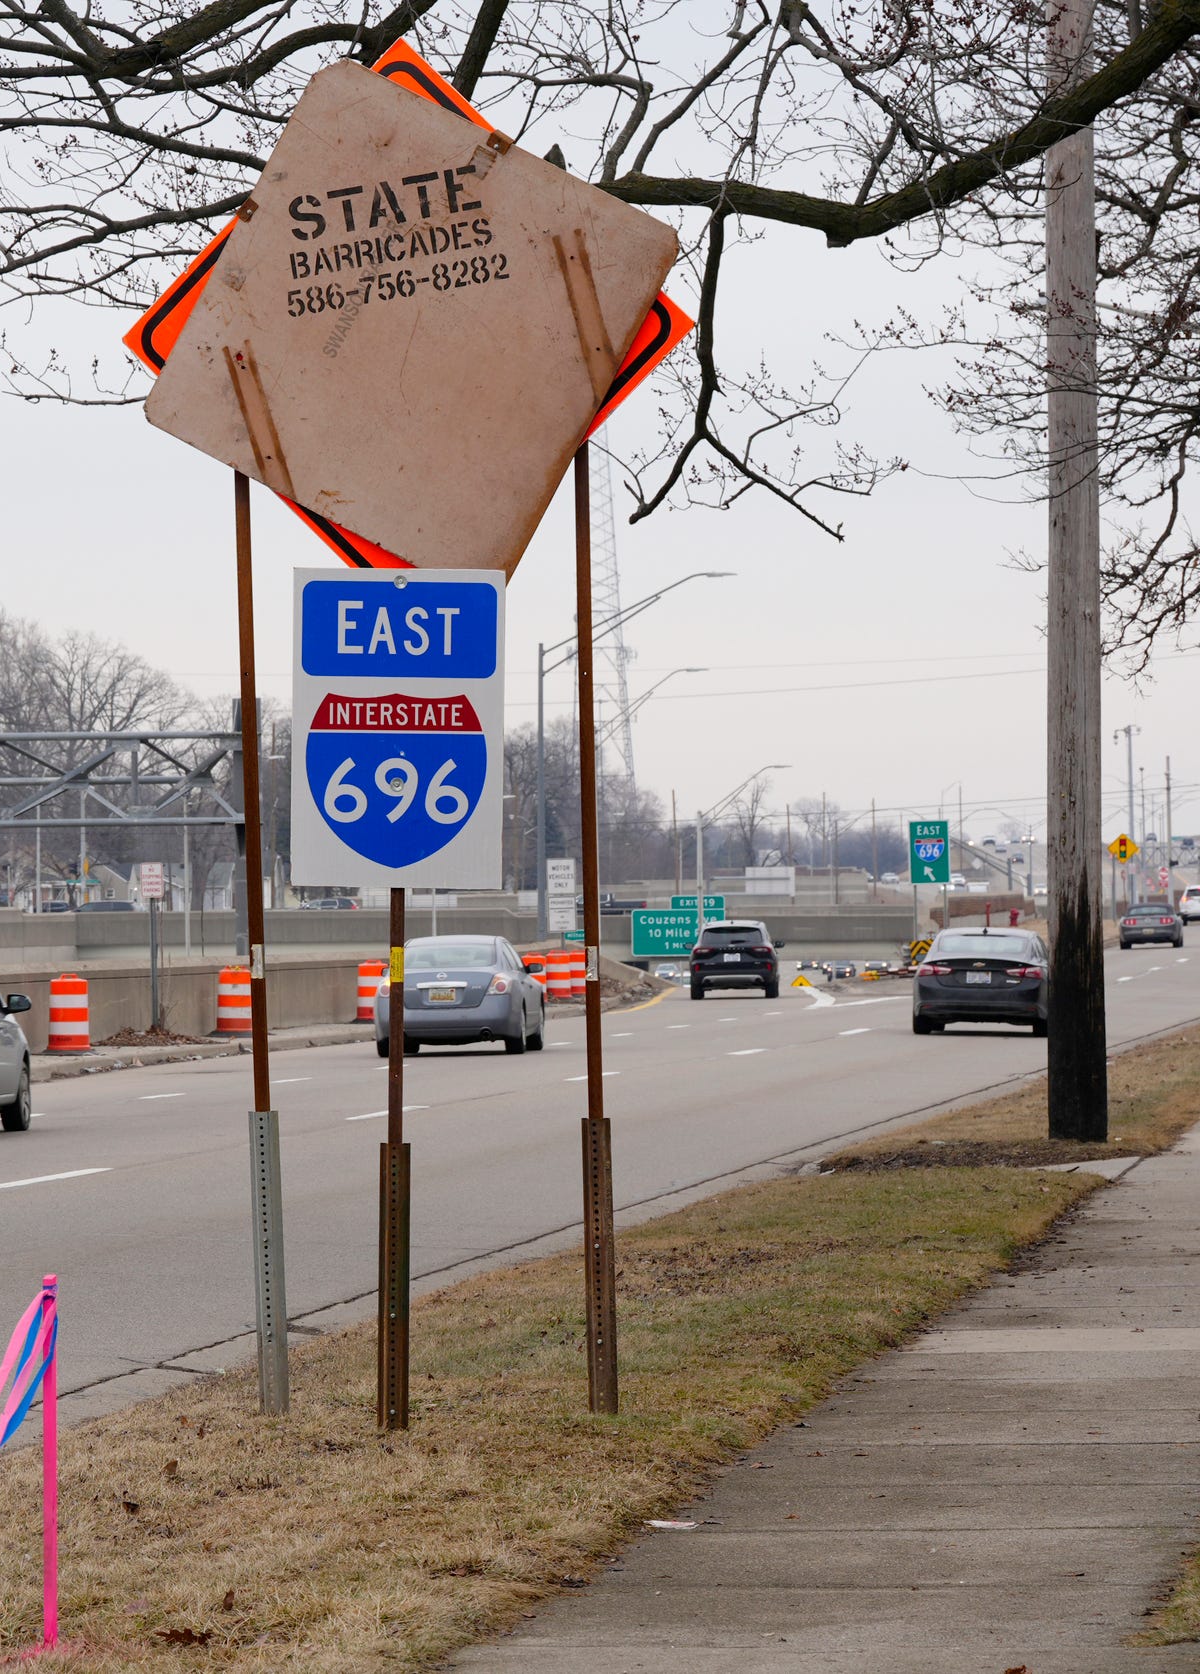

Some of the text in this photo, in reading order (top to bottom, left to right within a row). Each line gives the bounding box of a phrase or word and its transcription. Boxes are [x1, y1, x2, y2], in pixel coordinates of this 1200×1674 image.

[288, 164, 482, 241] STATE
[290, 218, 493, 280] BARRICADES
[287, 253, 510, 317] 586-756-8282
[337, 600, 460, 656] EAST
[329, 702, 463, 726] INTERSTATE
[323, 757, 469, 825] 696
[917, 825, 940, 836] EAST
[919, 844, 940, 858] 696
[704, 899, 715, 907] 19
[640, 915, 691, 925] Couzens
[649, 929, 662, 938] 10
[665, 929, 690, 938] Mile
